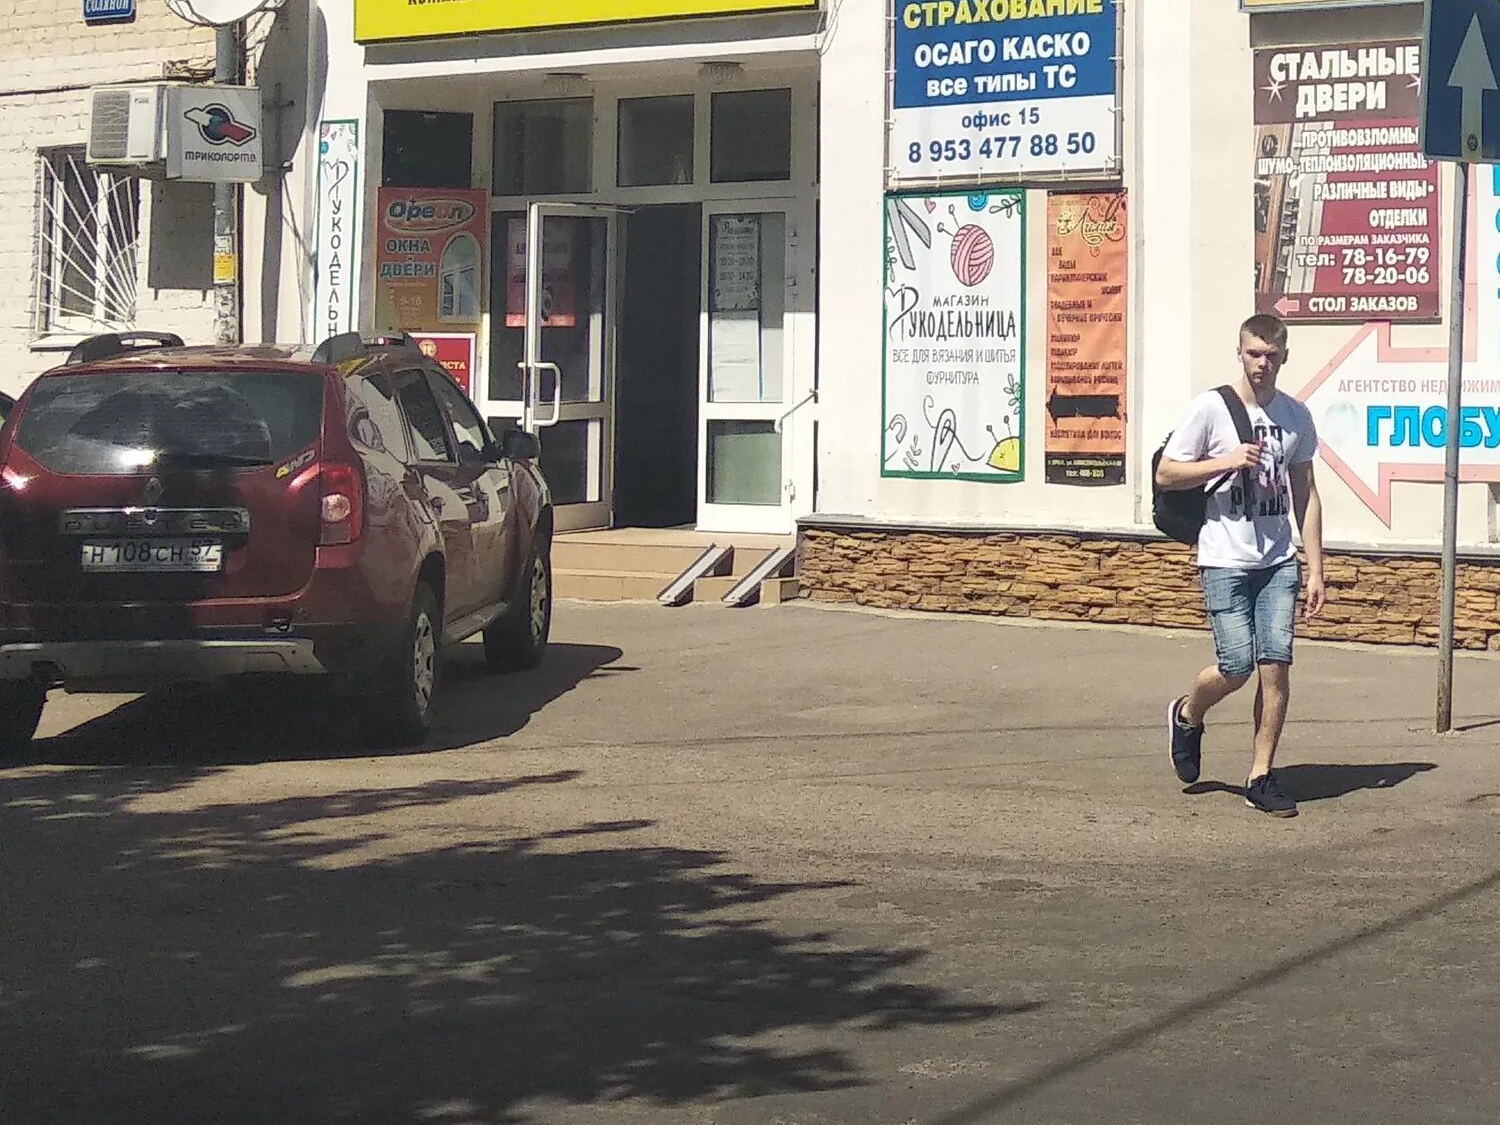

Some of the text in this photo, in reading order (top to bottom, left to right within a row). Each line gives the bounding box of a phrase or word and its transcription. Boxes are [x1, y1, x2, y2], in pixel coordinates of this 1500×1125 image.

[914, 32, 1090, 68] ОСАГО КАСКО
[1270, 46, 1420, 83] СТАЛЬНЫЕ
[927, 64, 1077, 97] все типы ТС
[1295, 81, 1386, 118] ДВЕРИ
[962, 107, 1040, 131] офис 15
[908, 132, 1096, 163] 8 953 477 88 50
[1302, 127, 1419, 148] ПРОТИВОВЗЛОМНЫ
[1313, 180, 1427, 201] РАЗЛИЧНЫЕ ВИДЫ
[1369, 209, 1427, 228] ОТДЕЛКИ
[322, 159, 350, 339] РУКОДЕЛЬН
[386, 239, 431, 253] ОКНА
[1300, 233, 1429, 246] ПО РАЗМЕРАМ ЗАКАЗЧИКА
[1296, 247, 1429, 267] тел: 78-16-79
[380, 264, 435, 278] ДВЕРИ
[1342, 267, 1429, 285] 78-20-06
[932, 294, 989, 308] МАГАЗИН
[1308, 296, 1418, 312] СТОЛ ЗАКАЗОВ
[889, 284, 1016, 342] РУКОДЕЛЬНИЦА
[893, 348, 1016, 365] ВСЕ ДЛЯ ВЯЗАНИЯ И ШИТЬЯ
[926, 370, 980, 385] ФУРНИТУРА
[1338, 379, 1416, 393] АГЕНТСТВО
